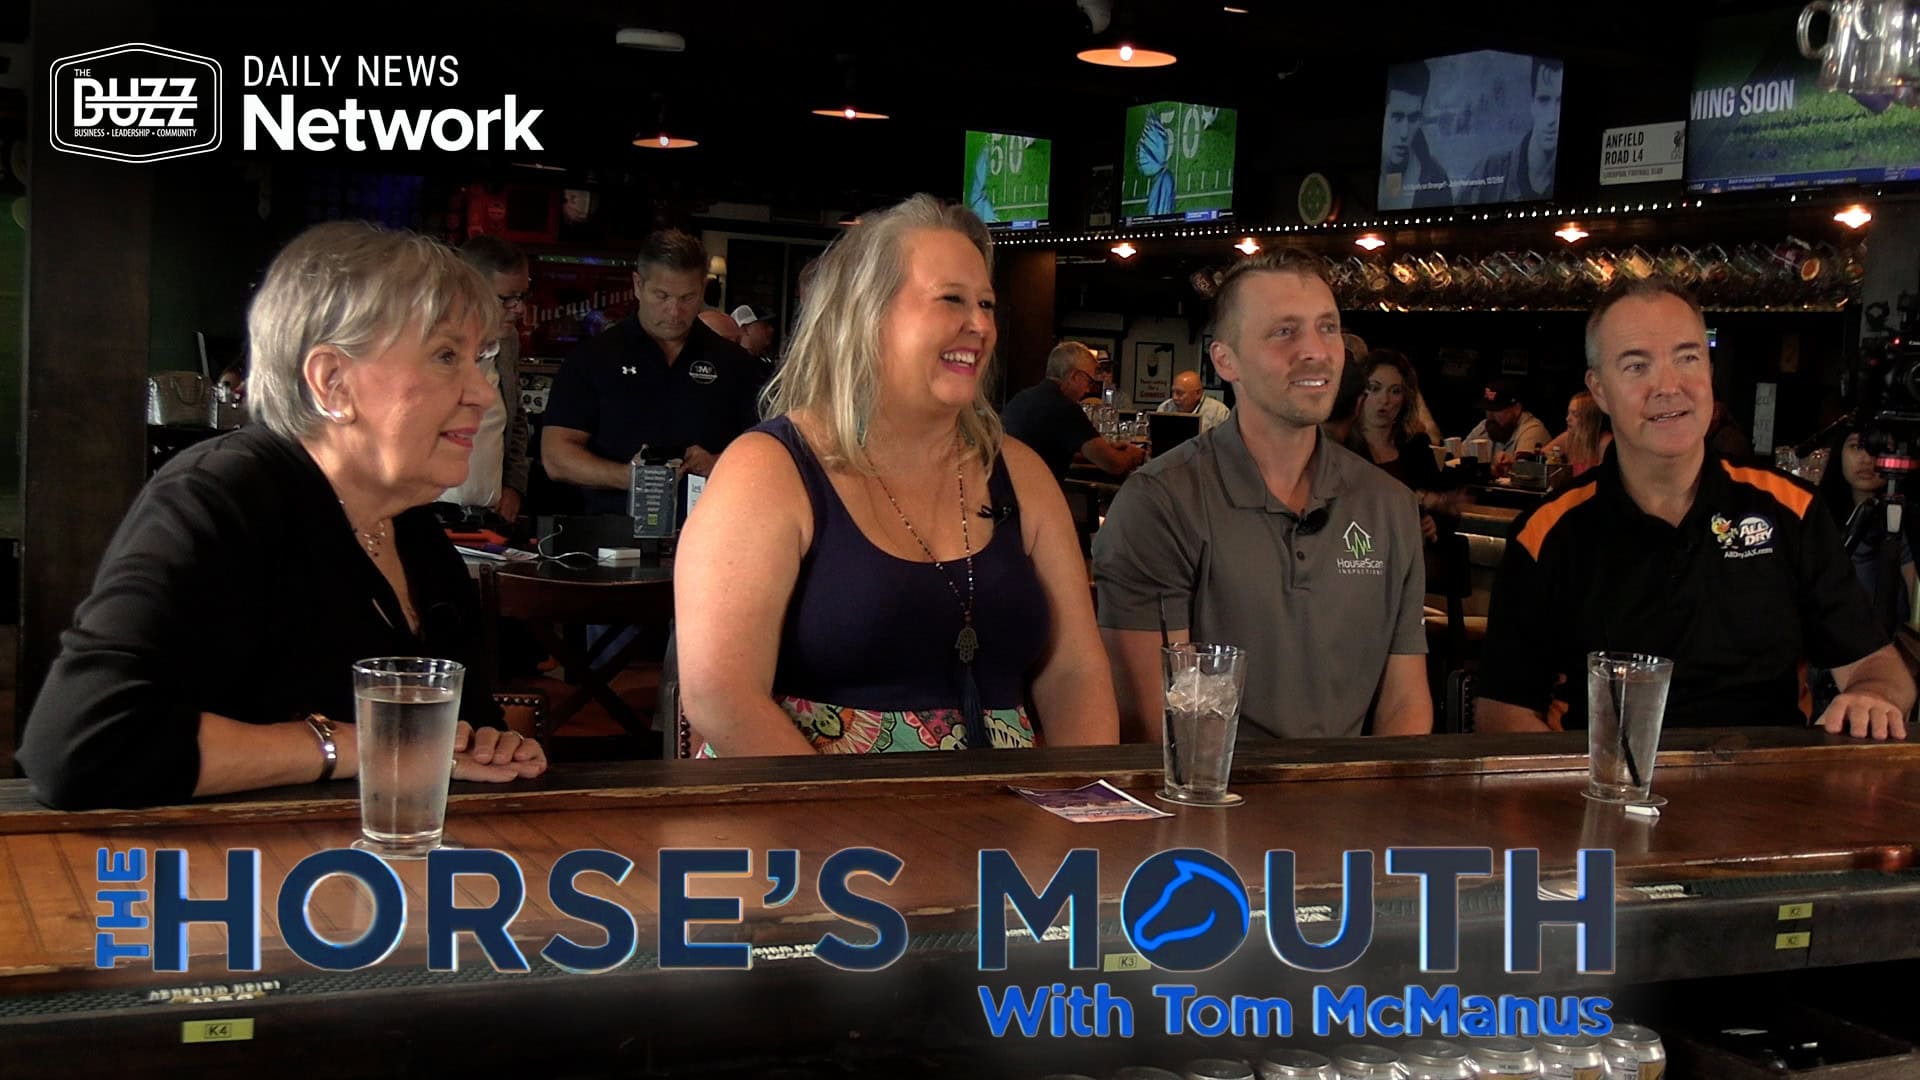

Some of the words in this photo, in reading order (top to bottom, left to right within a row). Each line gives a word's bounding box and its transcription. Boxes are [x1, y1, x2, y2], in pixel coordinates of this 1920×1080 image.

[1740, 79, 1795, 116] SOON
[1605, 131, 1645, 149] ANFIELD
[1604, 149, 1629, 166] ROAD
[1632, 148, 1644, 162] L4
[1739, 521, 1767, 539] ALL
[1744, 527, 1774, 547] DRY
[1336, 557, 1384, 569] HouseScan
[1121, 956, 1135, 968] K3
[208, 1024, 228, 1037] K4
